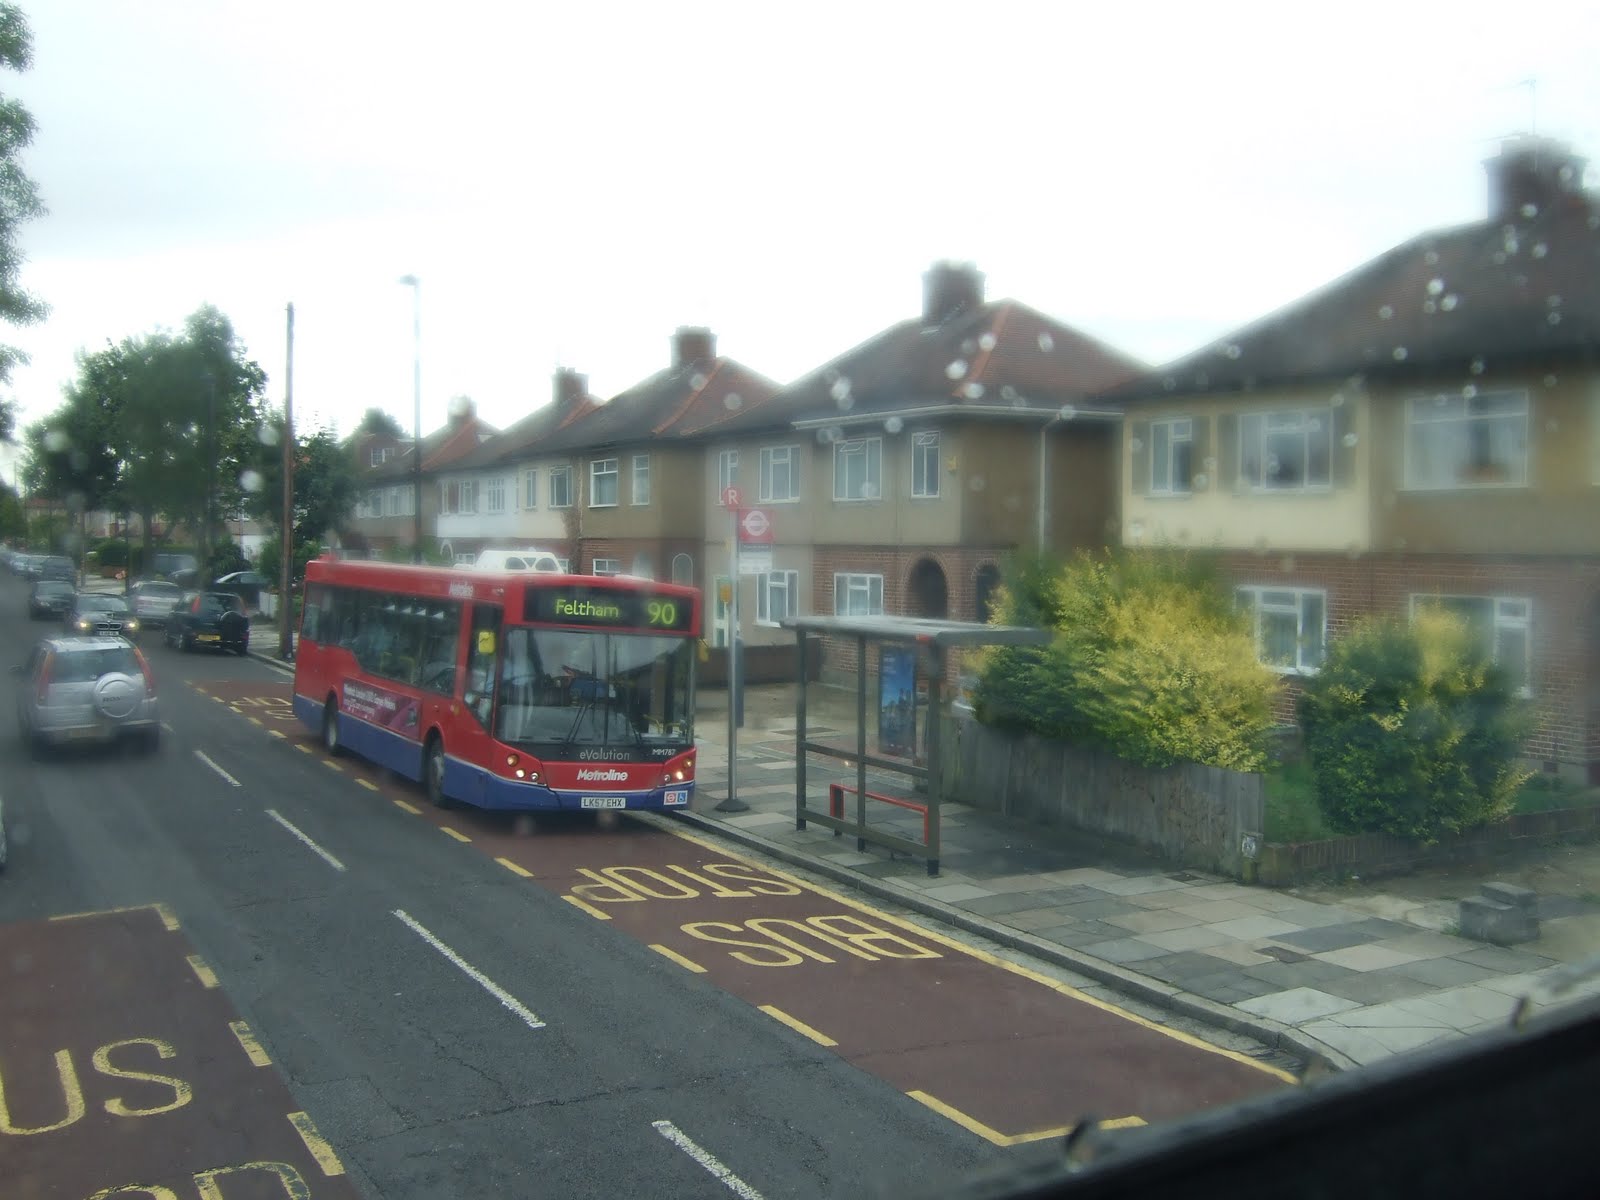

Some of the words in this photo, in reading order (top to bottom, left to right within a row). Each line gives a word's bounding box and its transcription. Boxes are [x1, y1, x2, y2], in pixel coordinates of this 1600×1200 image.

[727, 489, 739, 505] R
[555, 599, 619, 618] Feltham
[647, 601, 676, 625] 90
[579, 748, 630, 760] eVolution
[652, 748, 677, 756] MM787
[576, 768, 629, 781] Metroline
[606, 799, 622, 807] EHX
[570, 863, 803, 903] STOP
[679, 915, 944, 967] BUS
